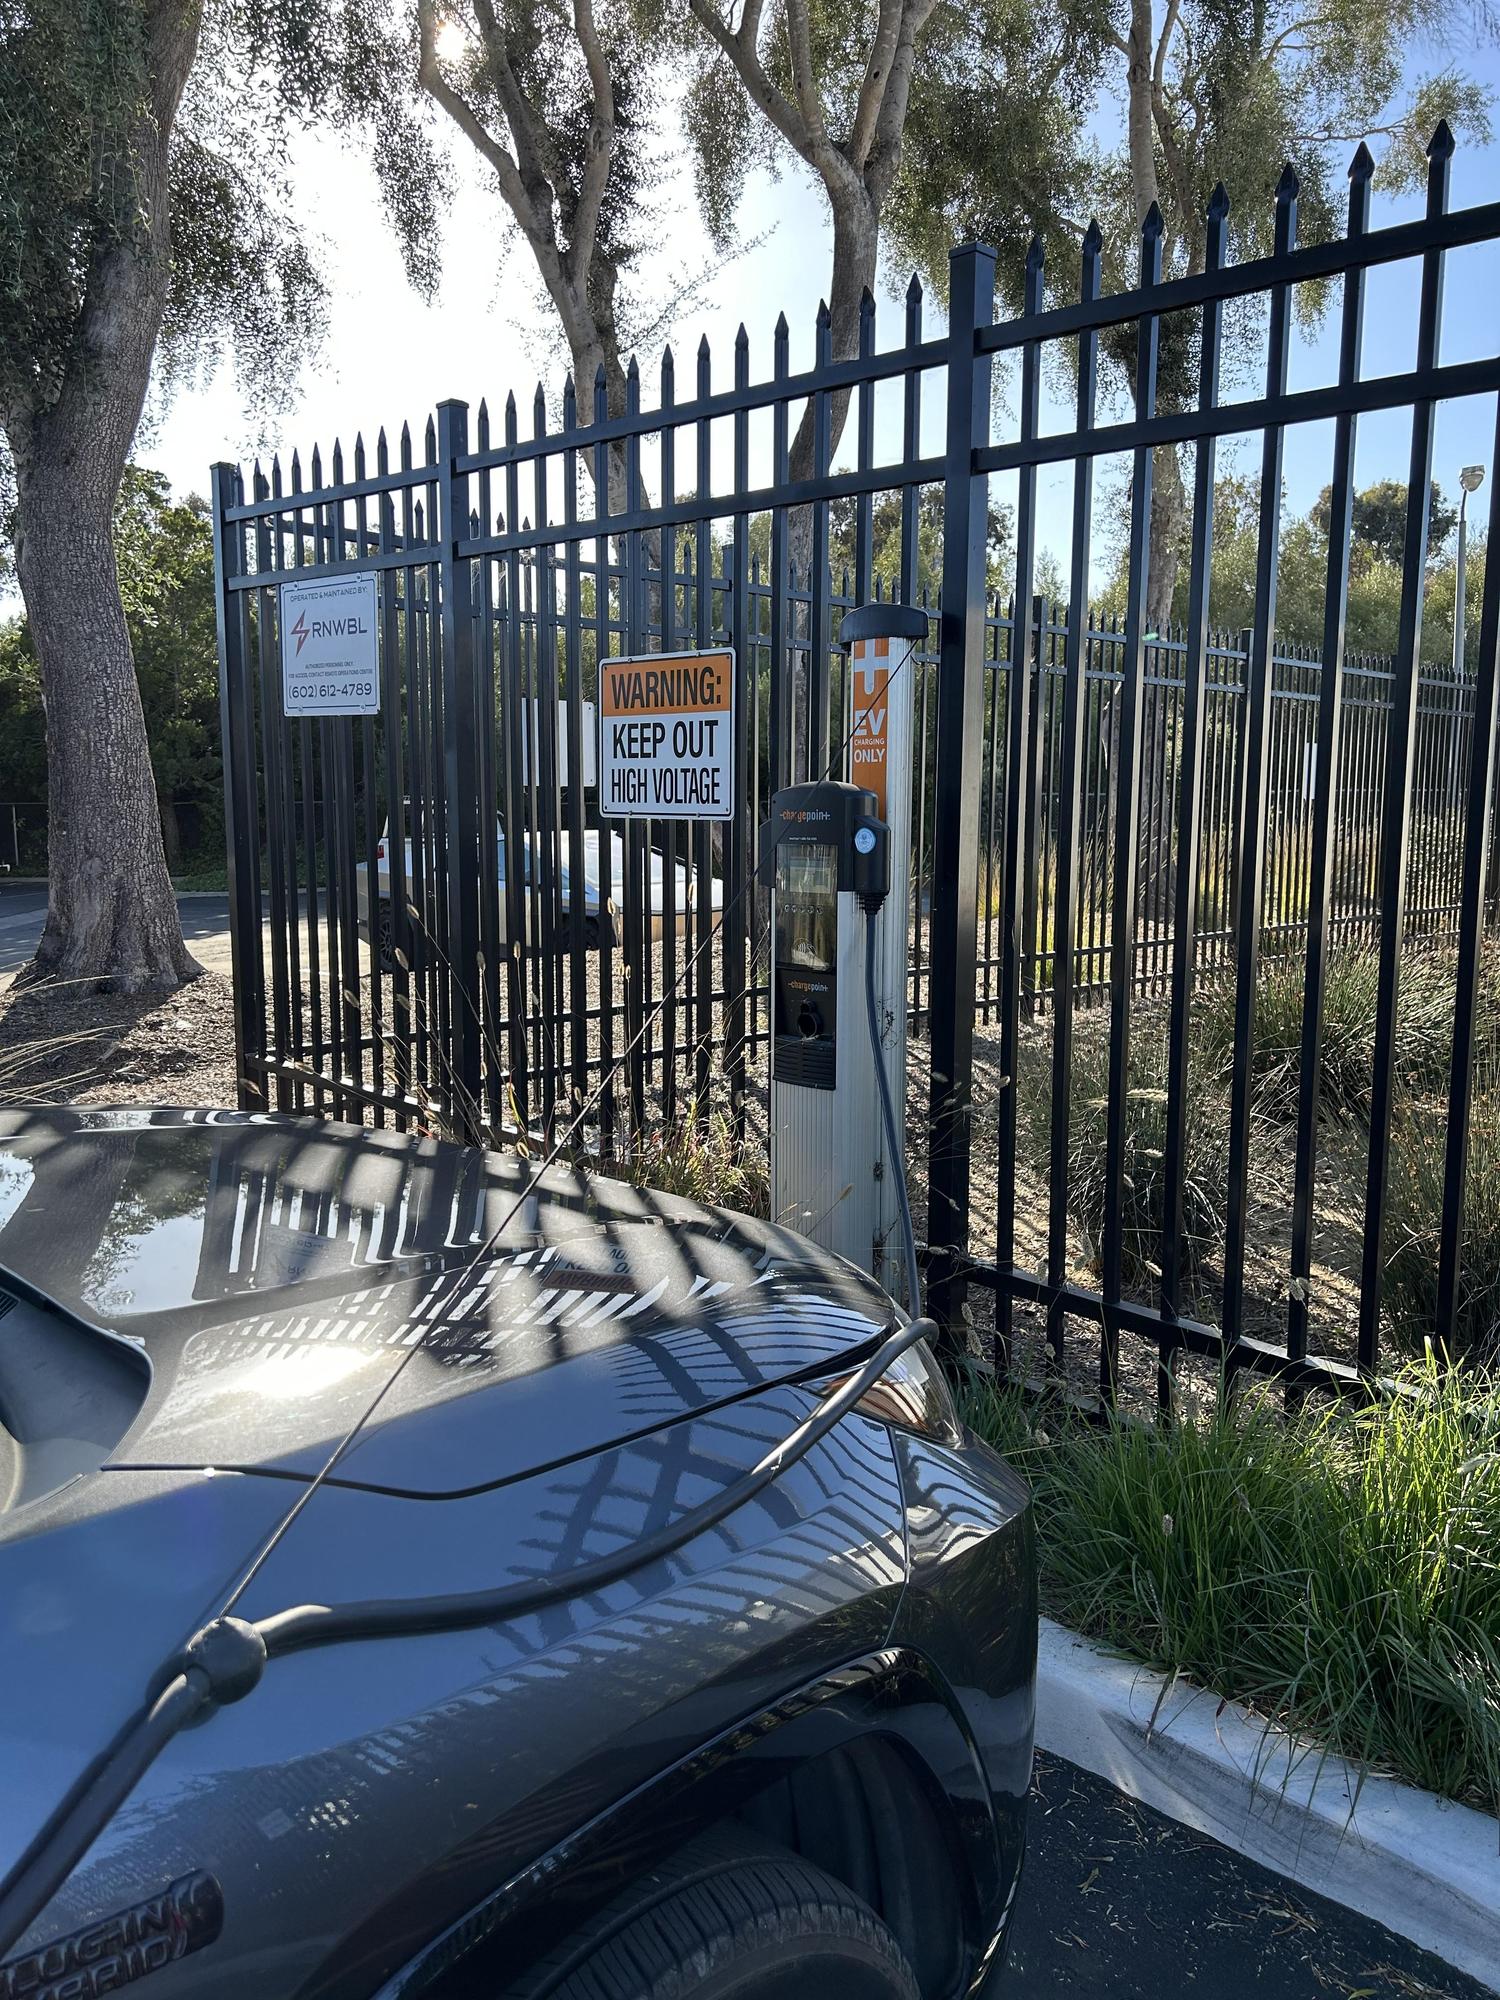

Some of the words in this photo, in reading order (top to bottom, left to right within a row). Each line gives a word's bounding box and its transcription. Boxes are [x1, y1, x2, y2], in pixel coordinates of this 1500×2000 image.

[289, 592, 318, 602] OPERATED
[323, 587, 357, 599] MAINTAINED
[312, 617, 368, 638] RNWBL
[288, 684, 318, 699] (602)
[319, 682, 372, 698] 612-4789
[611, 666, 722, 709] WARNING:
[854, 708, 886, 737] EV
[613, 722, 666, 759] KEEP
[672, 719, 719, 759] OUT
[854, 738, 885, 746] CHARGING
[853, 748, 885, 763] ONLY
[611, 768, 648, 804] HIGH
[652, 767, 721, 805] VOLTAGE
